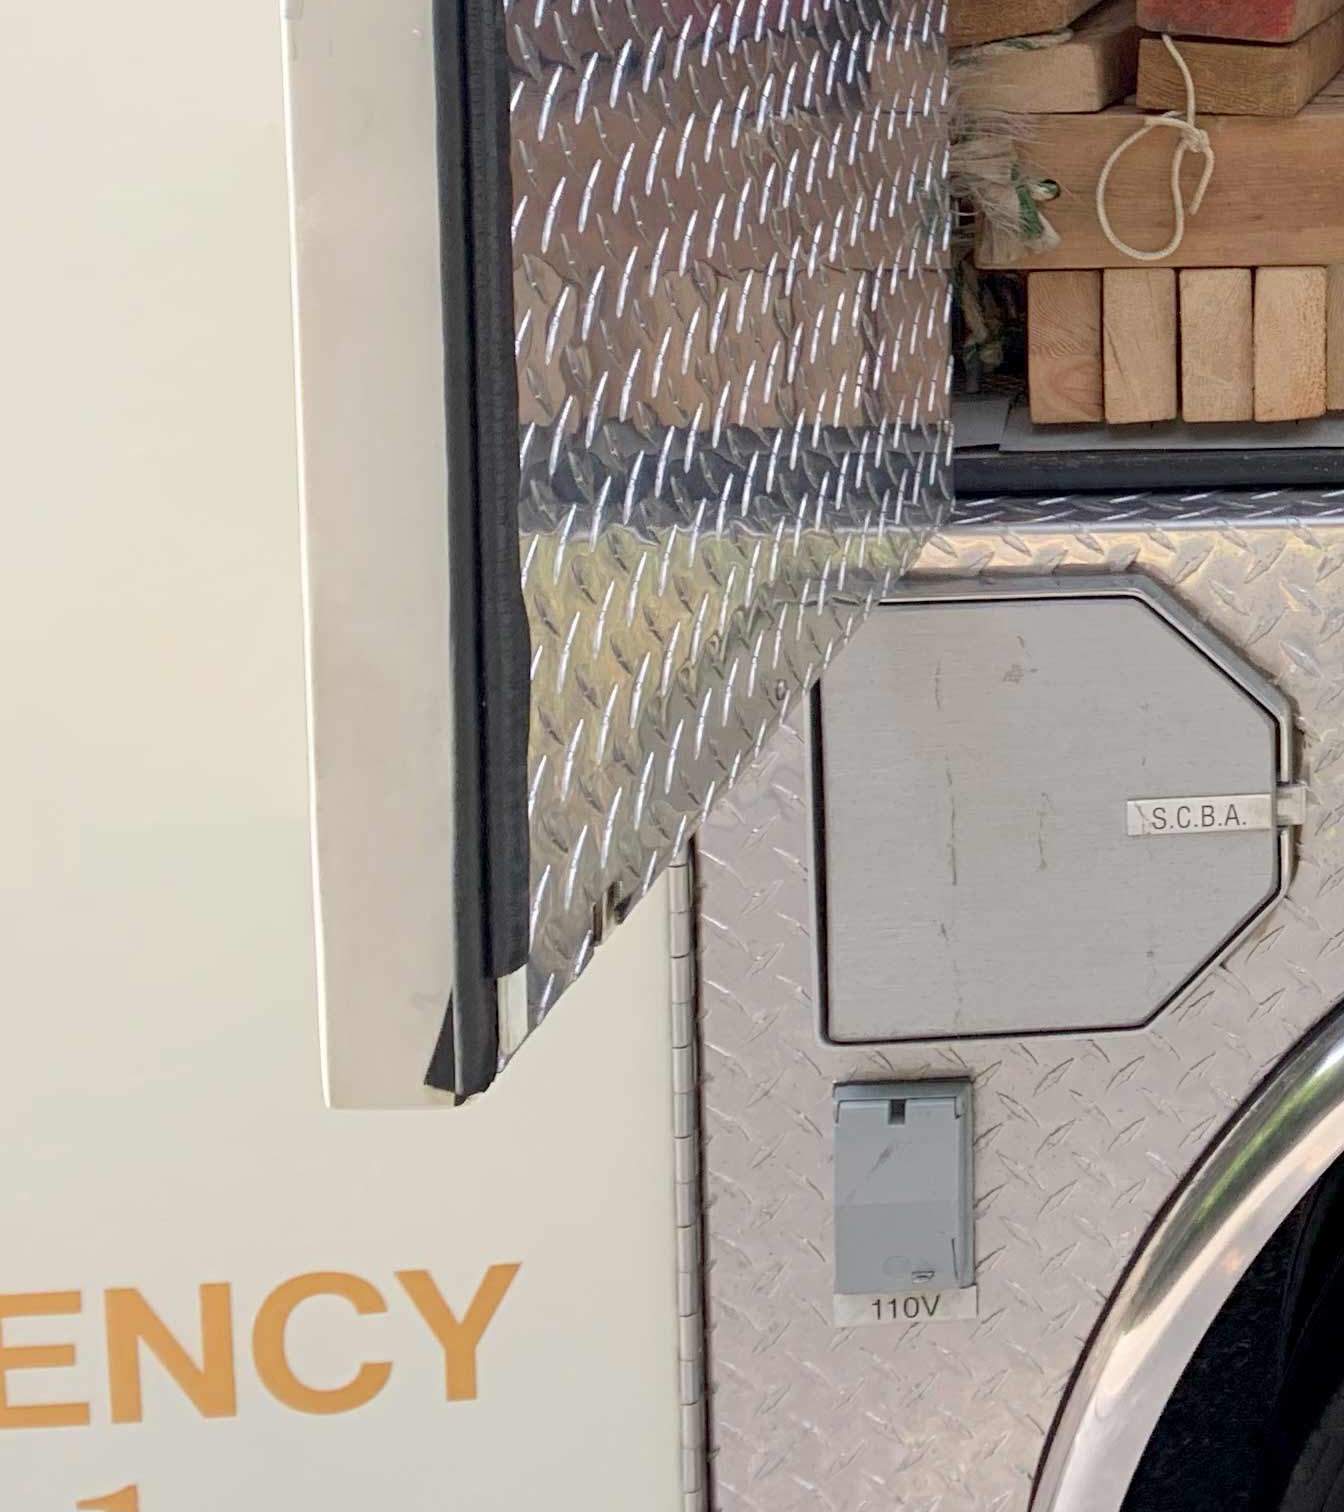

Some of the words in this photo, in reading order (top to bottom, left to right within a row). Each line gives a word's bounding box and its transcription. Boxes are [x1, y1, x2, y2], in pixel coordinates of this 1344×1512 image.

[1151, 803, 1248, 830] S.C.B.A.
[871, 1294, 941, 1320] 110V
[0, 1261, 523, 1430] ENCY
